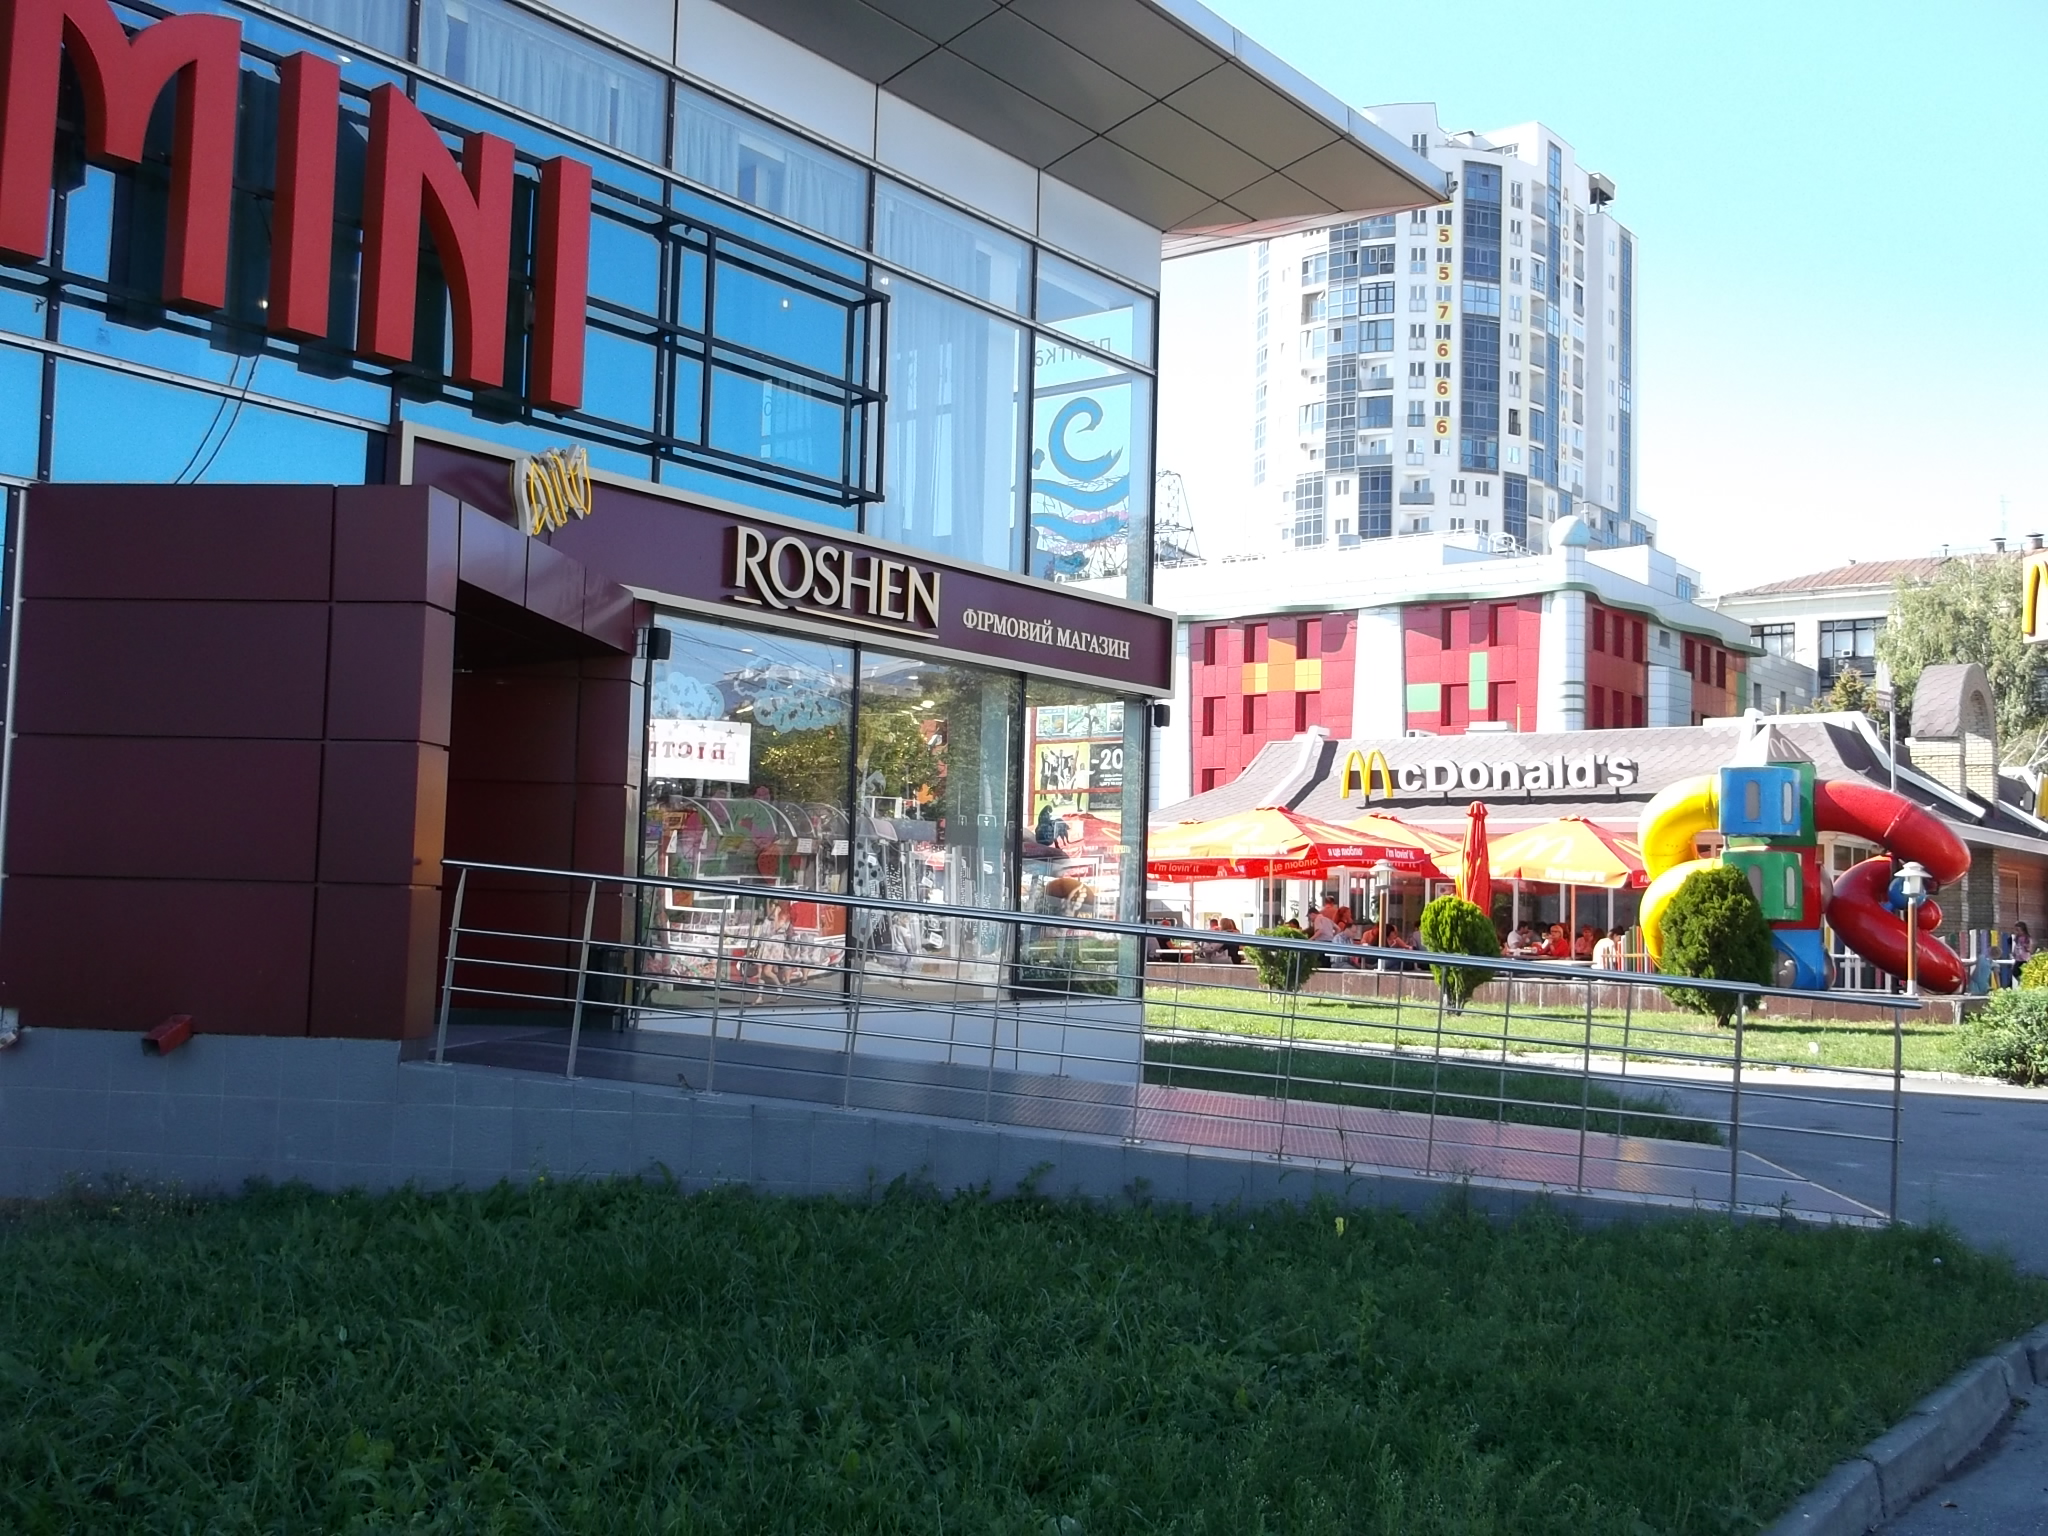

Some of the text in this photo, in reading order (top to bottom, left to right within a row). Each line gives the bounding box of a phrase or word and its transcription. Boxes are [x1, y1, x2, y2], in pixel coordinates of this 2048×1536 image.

[0, 0, 592, 413] MINI
[733, 525, 941, 629] ROSHEN
[962, 608, 1131, 660] ФІРМОВИЙ МАГАЗИН
[1340, 749, 1638, 798] McDonald's
